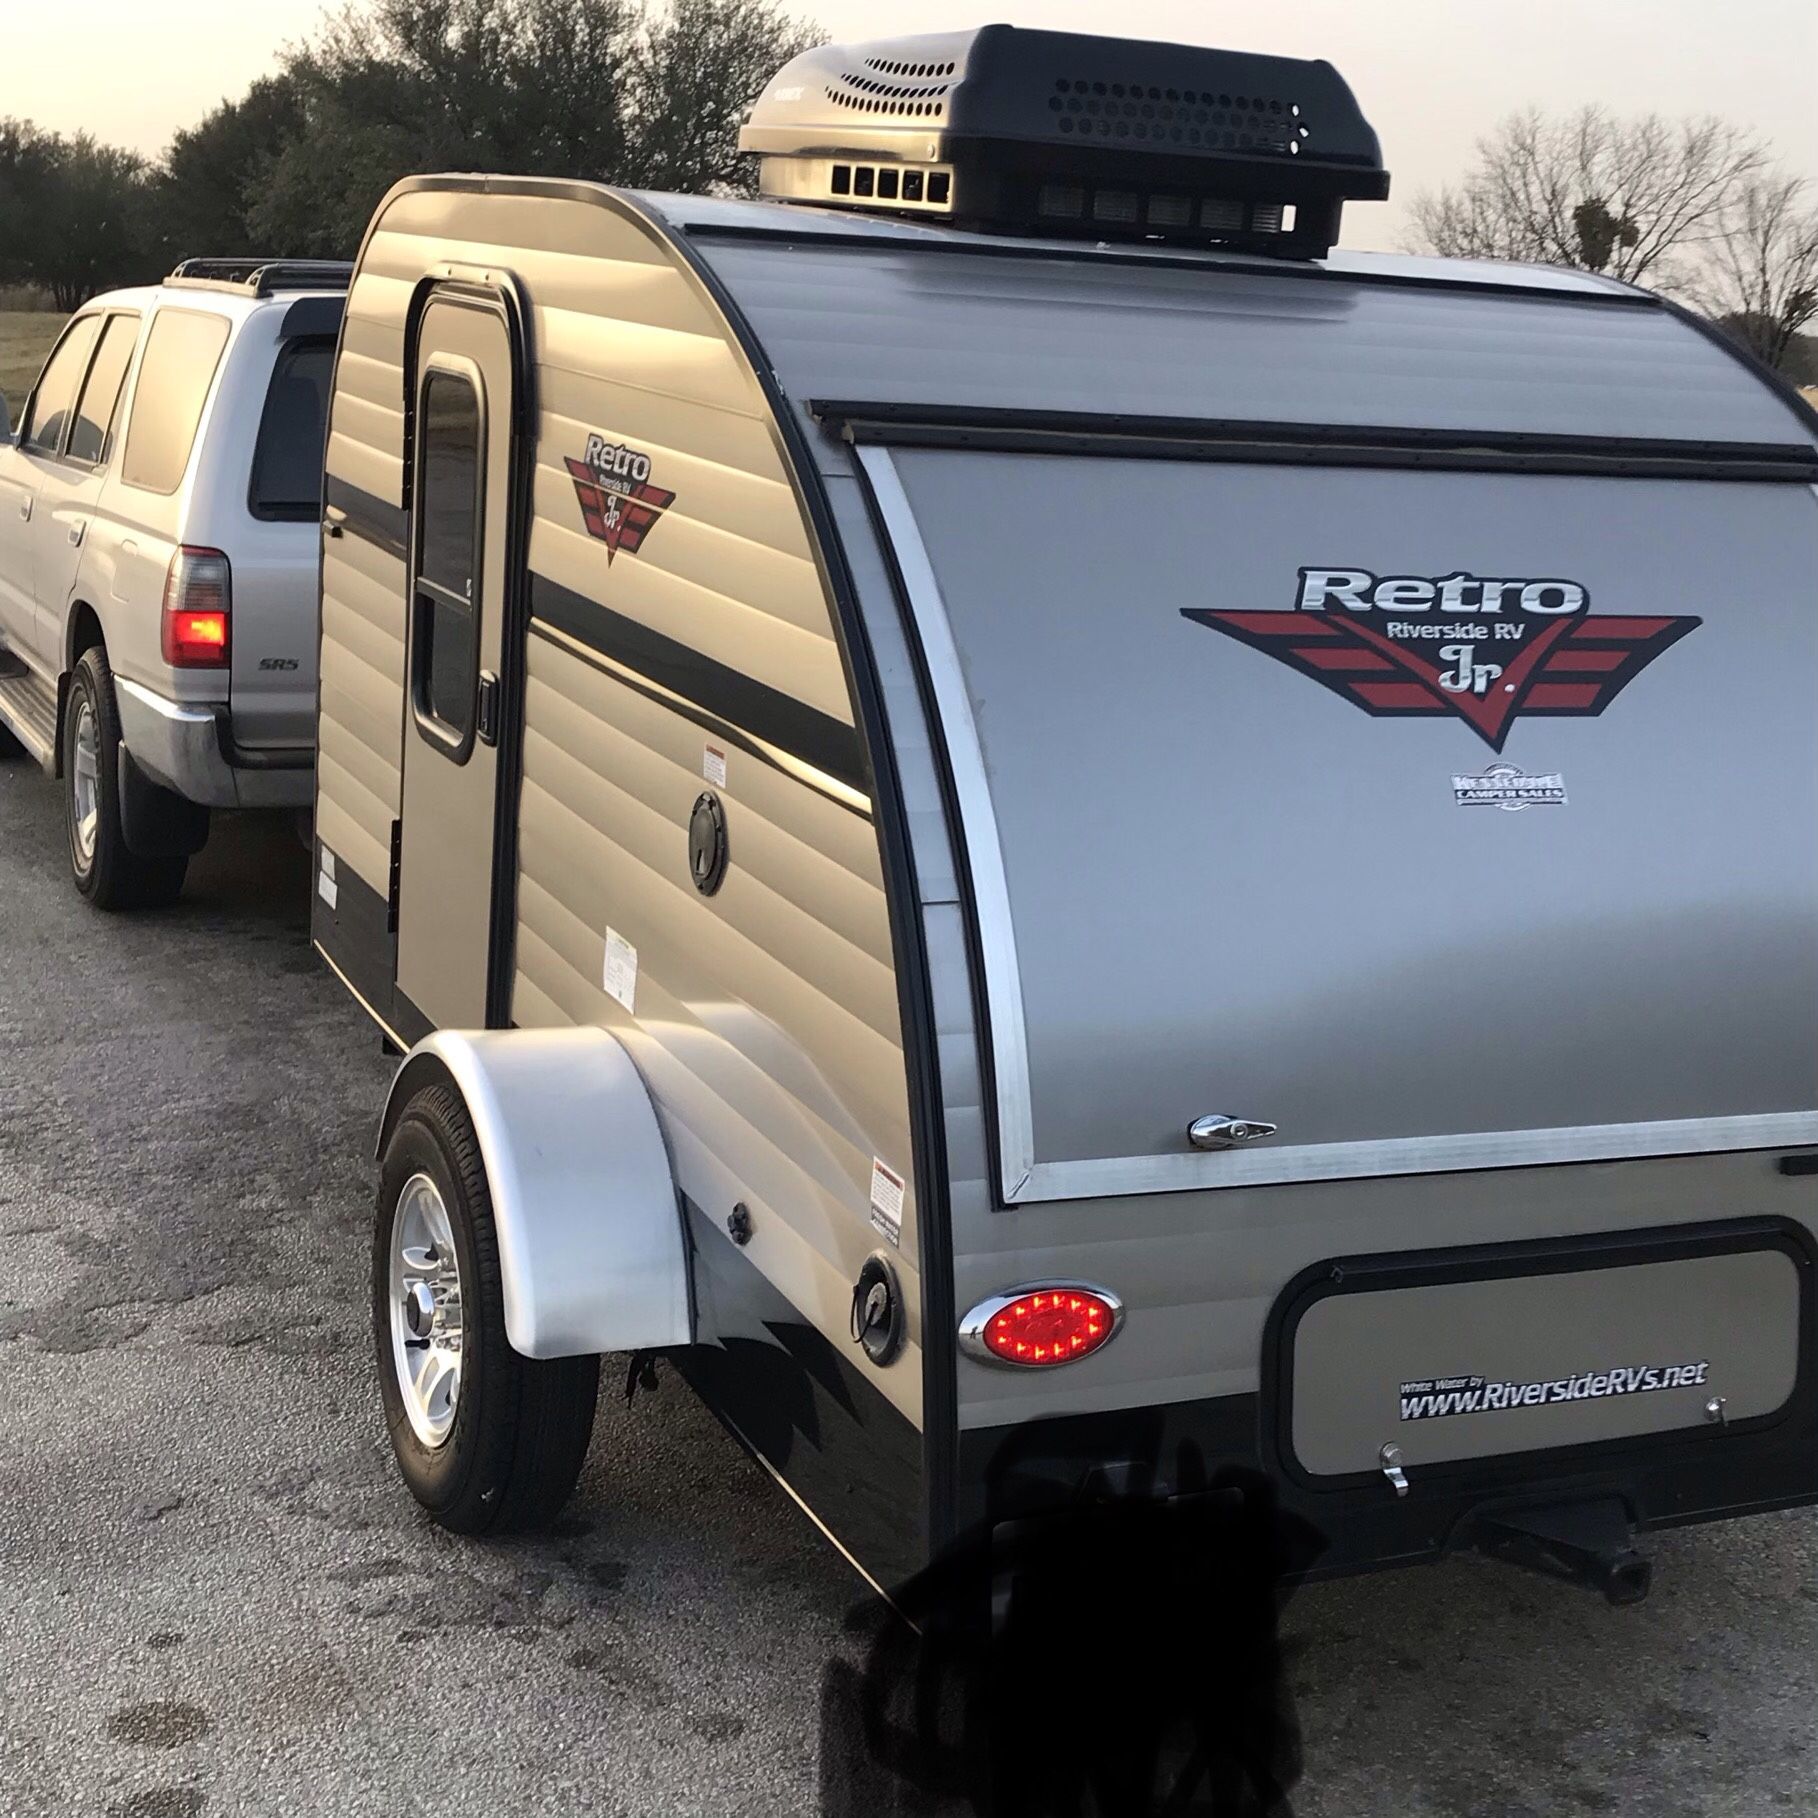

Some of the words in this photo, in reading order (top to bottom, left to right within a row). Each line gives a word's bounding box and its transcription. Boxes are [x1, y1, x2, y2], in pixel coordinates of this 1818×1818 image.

[584, 435, 650, 481] Retro
[603, 495, 621, 532] Jr.
[1300, 569, 1584, 615] Retro
[1386, 622, 1489, 640] Riverside
[1494, 622, 1526, 640] RV
[1438, 644, 1516, 693] Jr.
[1456, 789, 1517, 799] CAMPER
[1518, 788, 1562, 798] SALES
[1400, 1361, 1709, 1420] www.RiversideRVs.net
[1469, 1376, 1484, 1388] by
